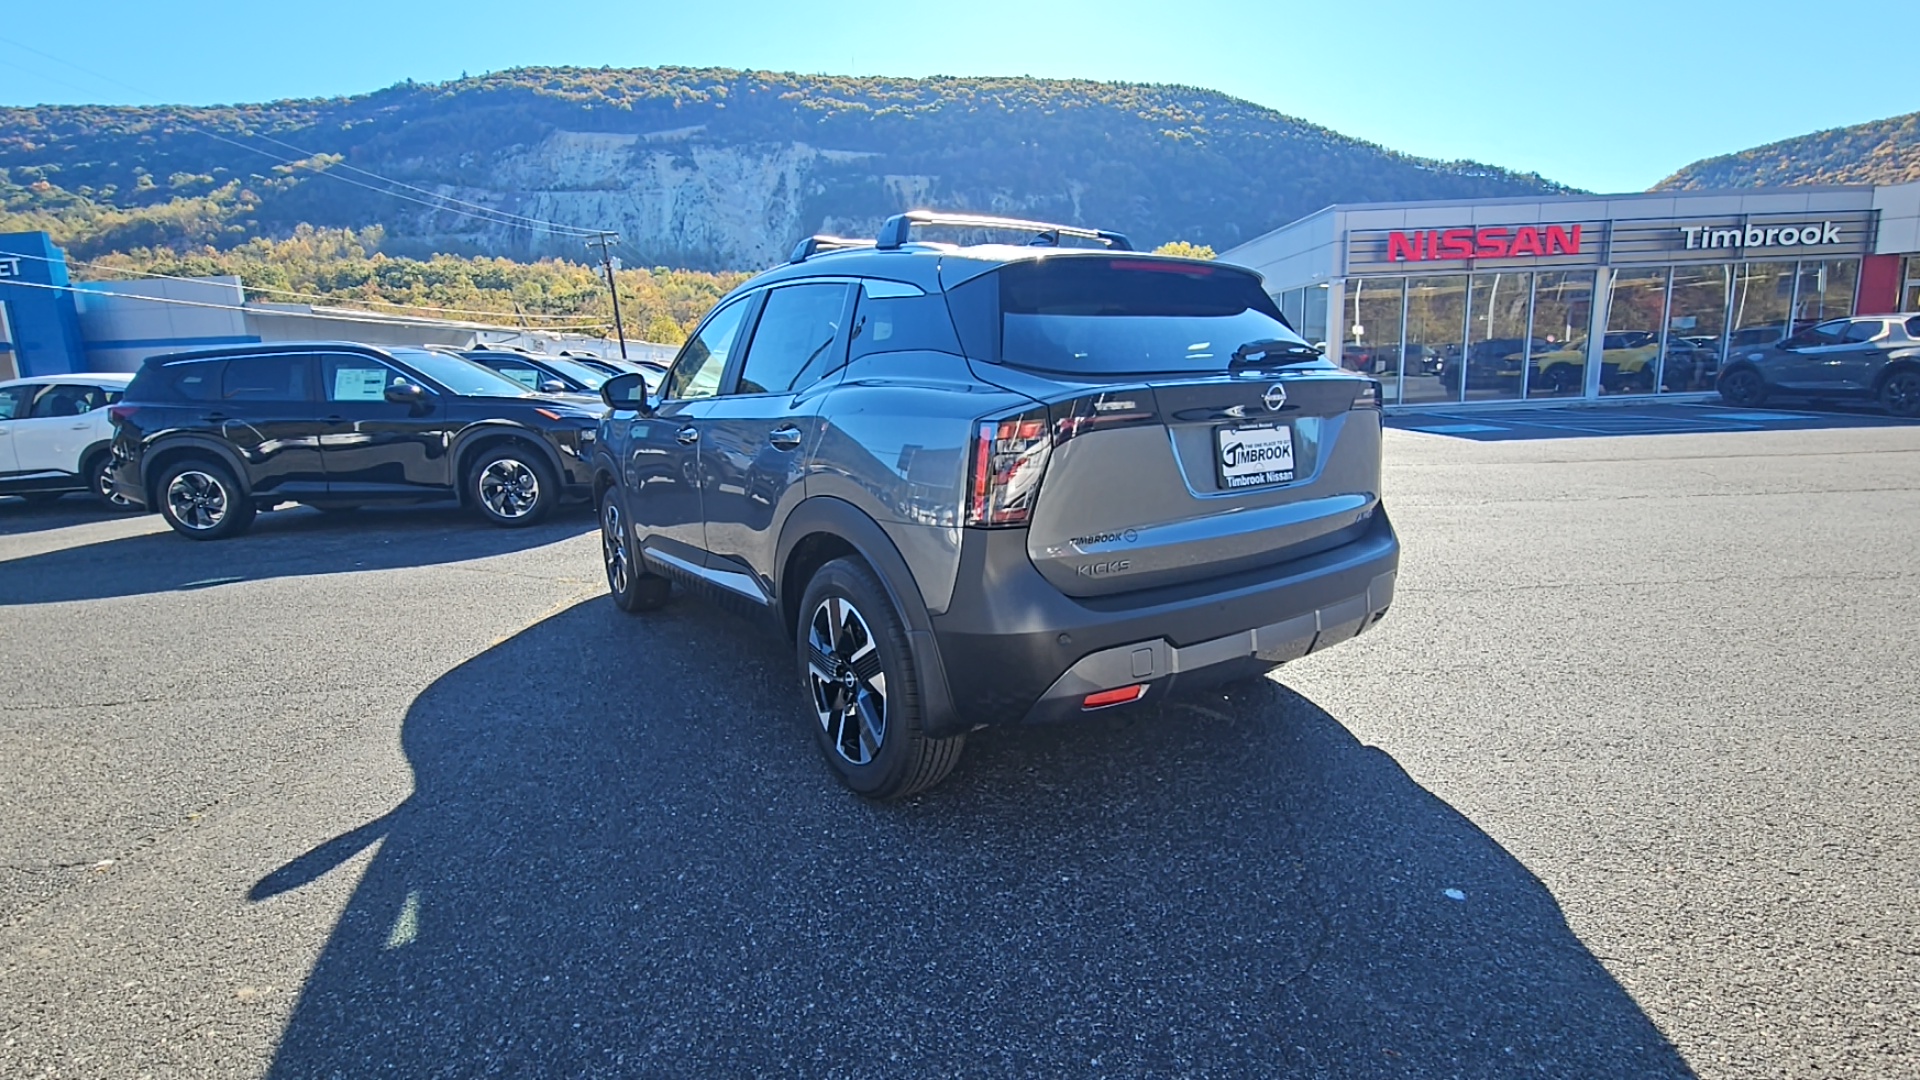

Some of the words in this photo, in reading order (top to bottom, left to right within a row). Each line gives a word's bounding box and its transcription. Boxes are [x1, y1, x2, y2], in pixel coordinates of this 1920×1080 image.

[1387, 224, 1582, 262] NISSAN
[1681, 221, 1841, 250] Timbrook
[1222, 442, 1291, 468] TIMBROOK
[1226, 473, 1265, 488] Timbrook
[1266, 471, 1293, 483] Nissan
[1069, 533, 1122, 546] TIMBROOK
[1076, 559, 1131, 576] KICKS
